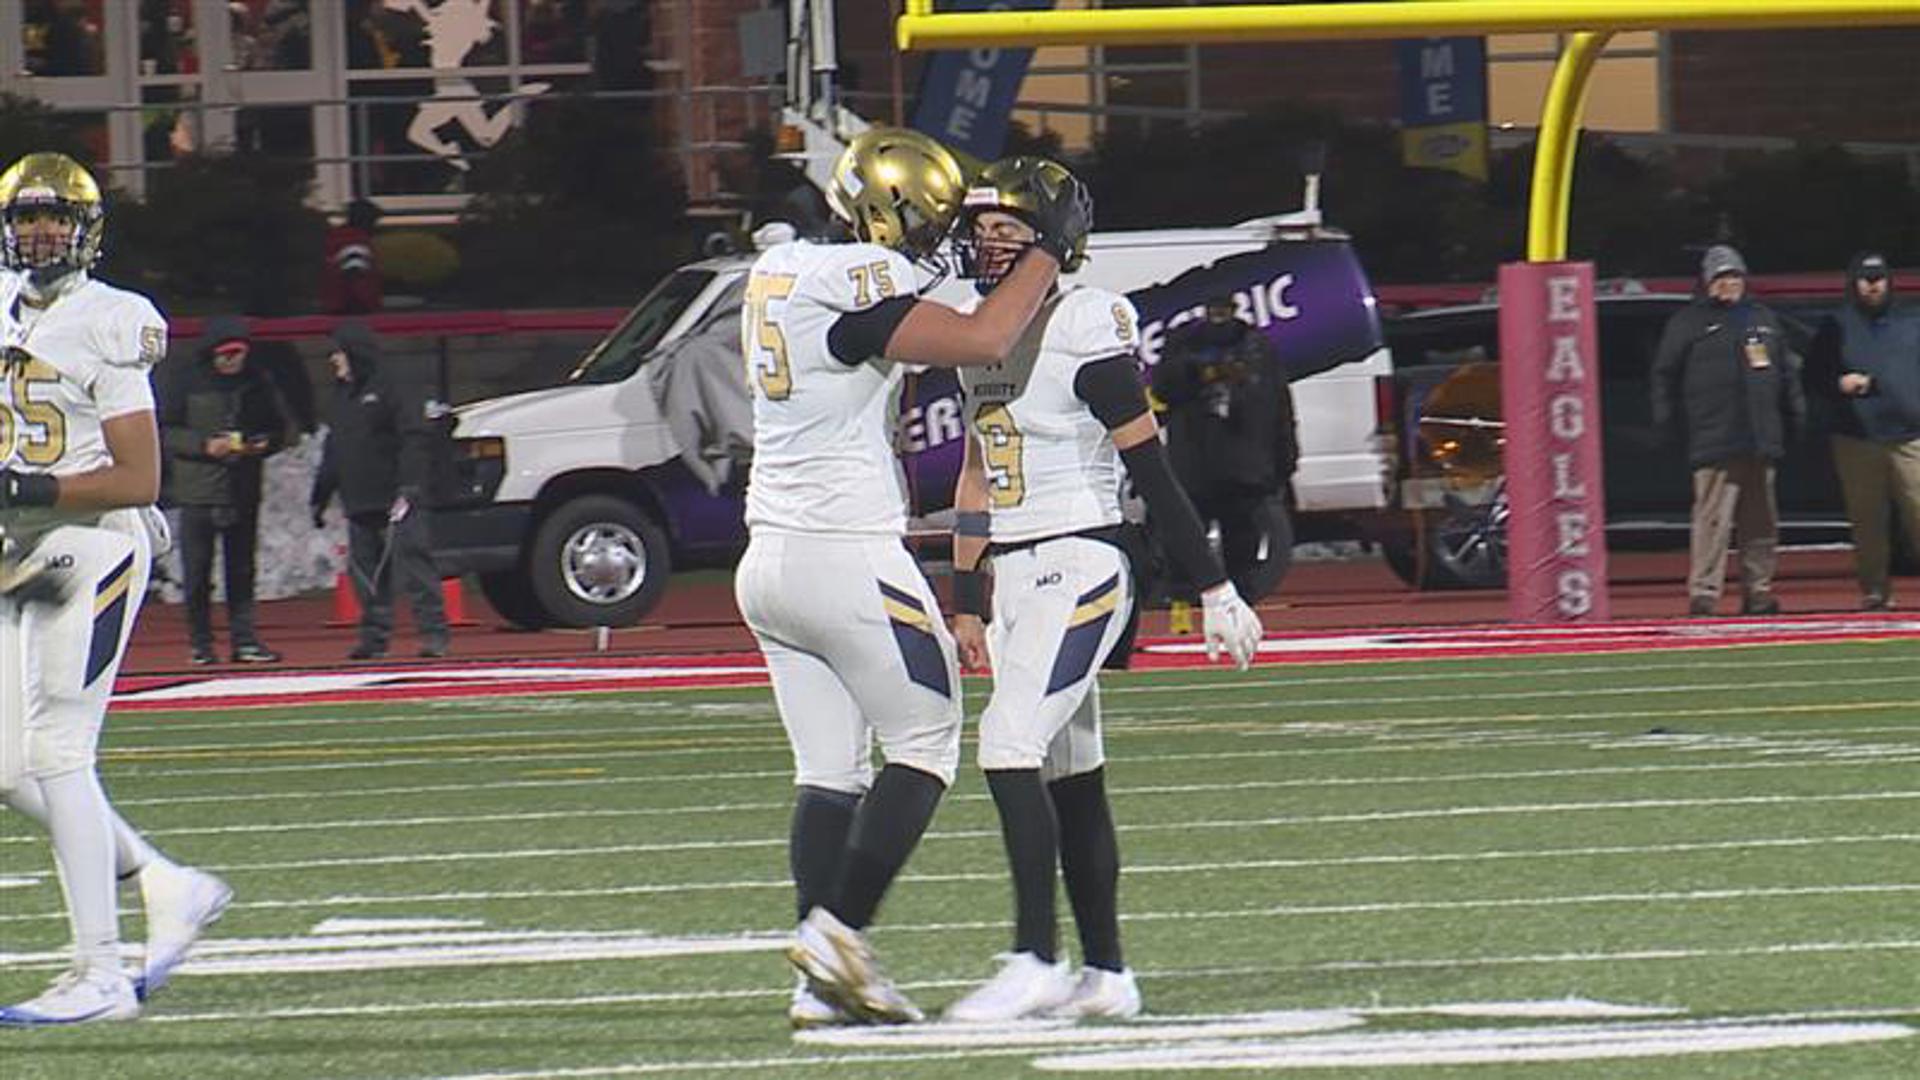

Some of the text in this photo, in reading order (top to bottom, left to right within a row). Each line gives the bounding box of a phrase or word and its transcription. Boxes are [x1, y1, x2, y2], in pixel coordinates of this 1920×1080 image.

[945, 46, 1001, 140] OME
[1421, 36, 1454, 115] ME
[847, 260, 896, 308] 75
[1111, 302, 1133, 341] 9
[0, 355, 66, 466] 5
[974, 401, 1026, 506] 9
[1545, 276, 1593, 617] EAGLES
